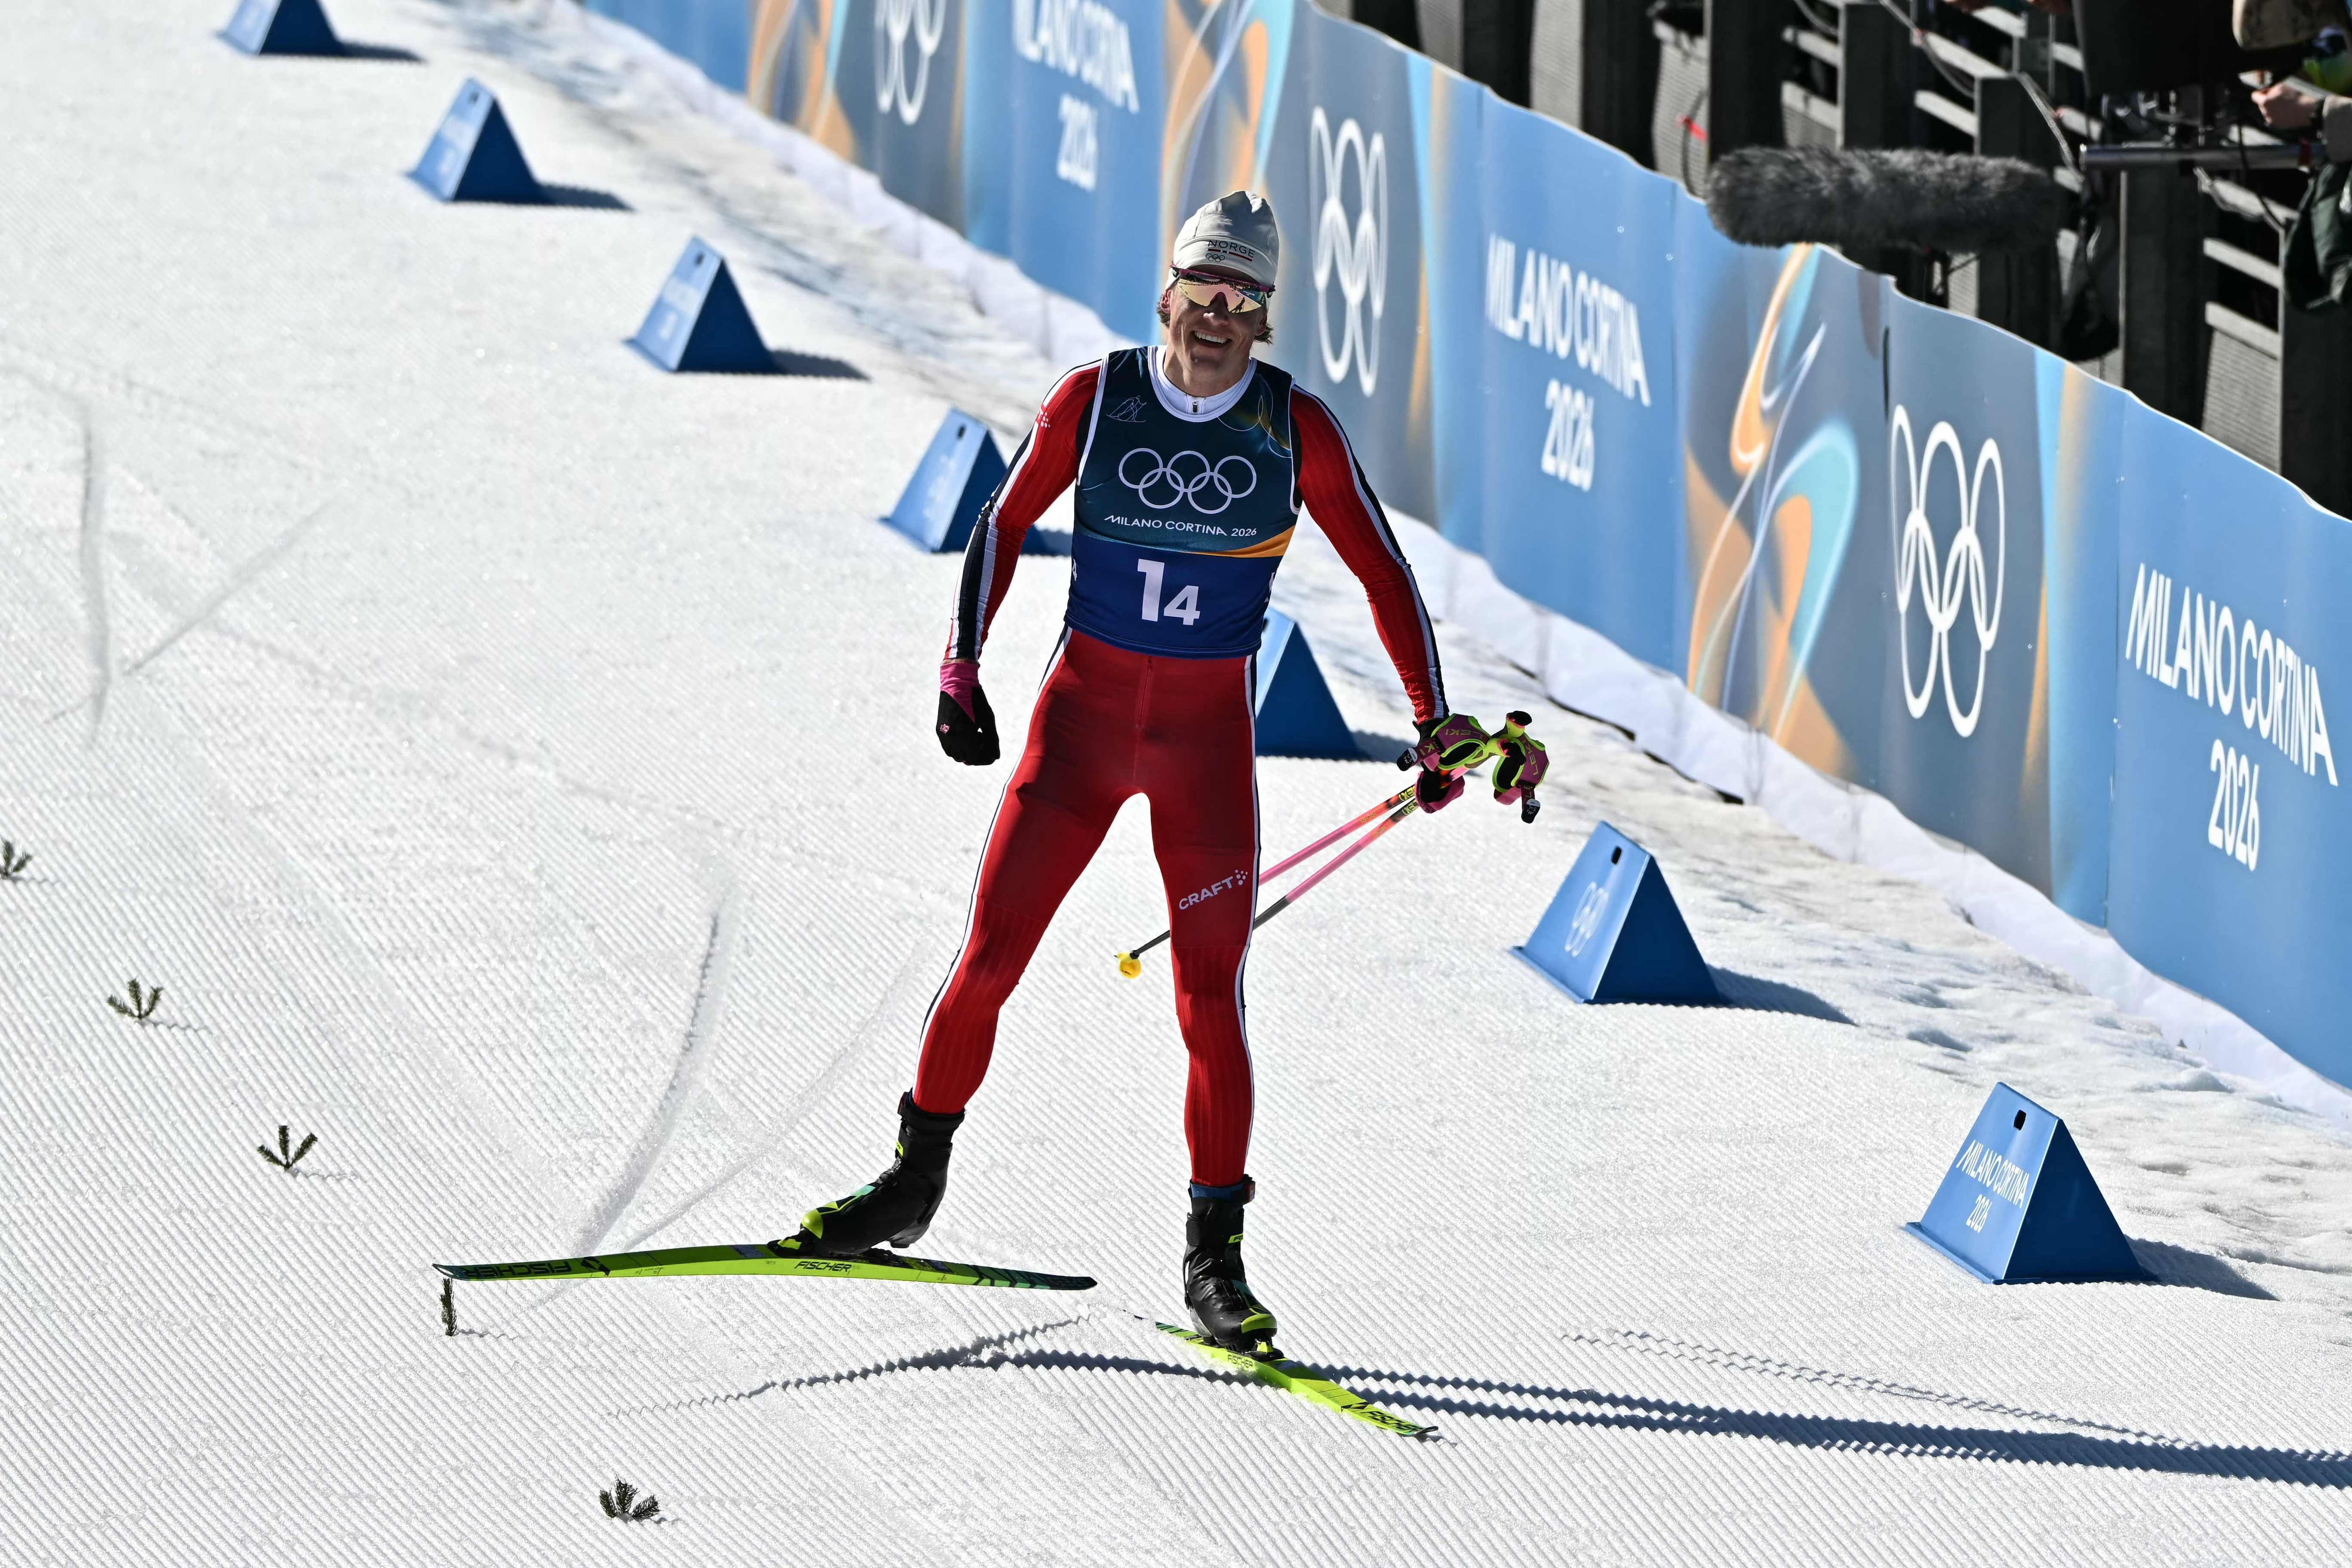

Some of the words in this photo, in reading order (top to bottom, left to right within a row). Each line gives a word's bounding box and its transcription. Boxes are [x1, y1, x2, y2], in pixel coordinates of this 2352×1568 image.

[1208, 239, 1255, 258] NORGE
[1485, 232, 1573, 359] MILANO
[1573, 271, 1652, 407] CORTINA
[1541, 378, 1595, 492] 2026
[1104, 515, 1162, 528] MILANO
[1165, 521, 1228, 536] CORTINA
[1231, 528, 1257, 536] 2026
[2125, 562, 2236, 716] MILANO
[2240, 619, 2338, 787] CORTINA
[1445, 729, 1483, 740] LEKI
[2208, 739, 2260, 871] 2026
[1178, 876, 1234, 910] CRAFT
[1956, 1139, 2002, 1188] MILANO
[1993, 1159, 2030, 1209] CORTINA
[1966, 1194, 1993, 1234] 2026
[794, 1261, 852, 1273] FISCHER
[1227, 1354, 1254, 1369] FISCHER
[1360, 1410, 1423, 1433] FISCHER
